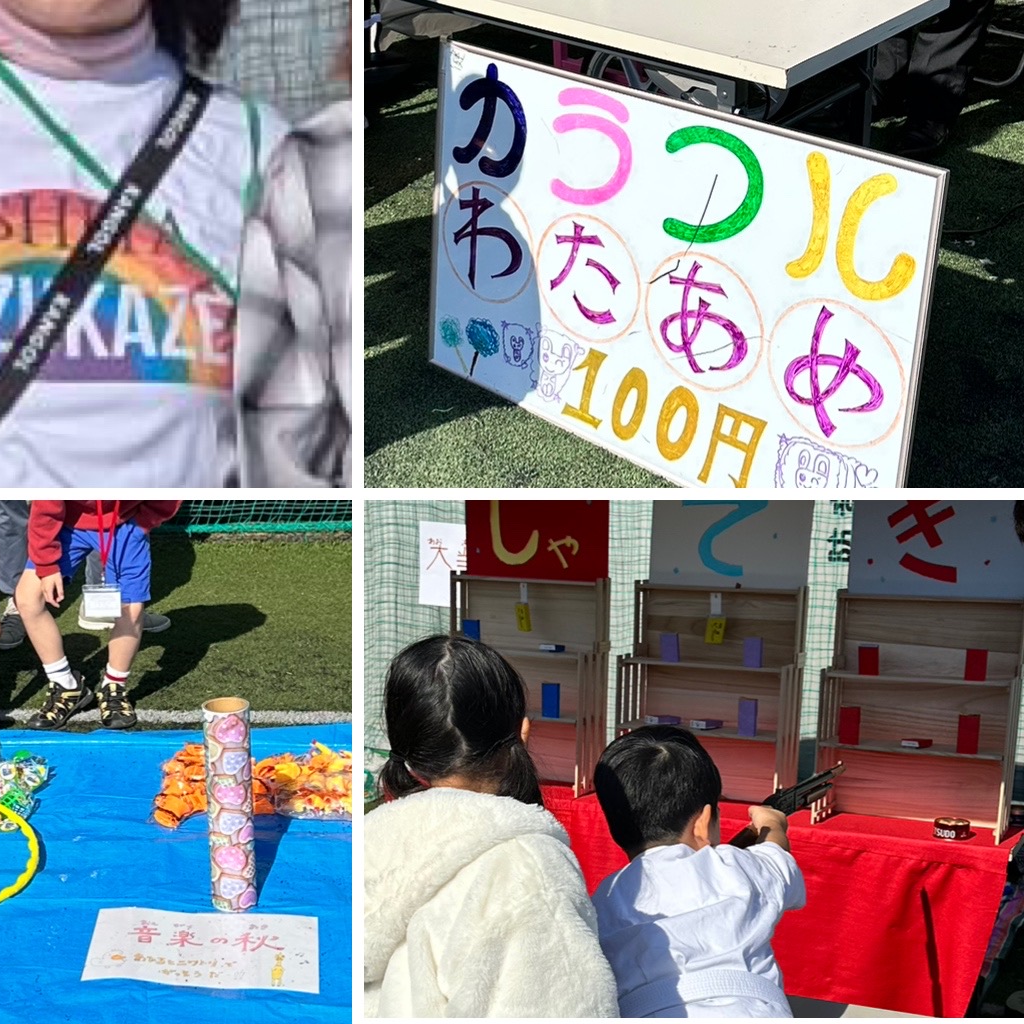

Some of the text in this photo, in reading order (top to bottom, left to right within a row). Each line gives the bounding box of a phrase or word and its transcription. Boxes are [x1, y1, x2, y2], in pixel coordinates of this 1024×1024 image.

[453, 186, 885, 439] わたあめ
[561, 347, 768, 489] 100円
[127, 926, 285, 952] 音楽の秋
